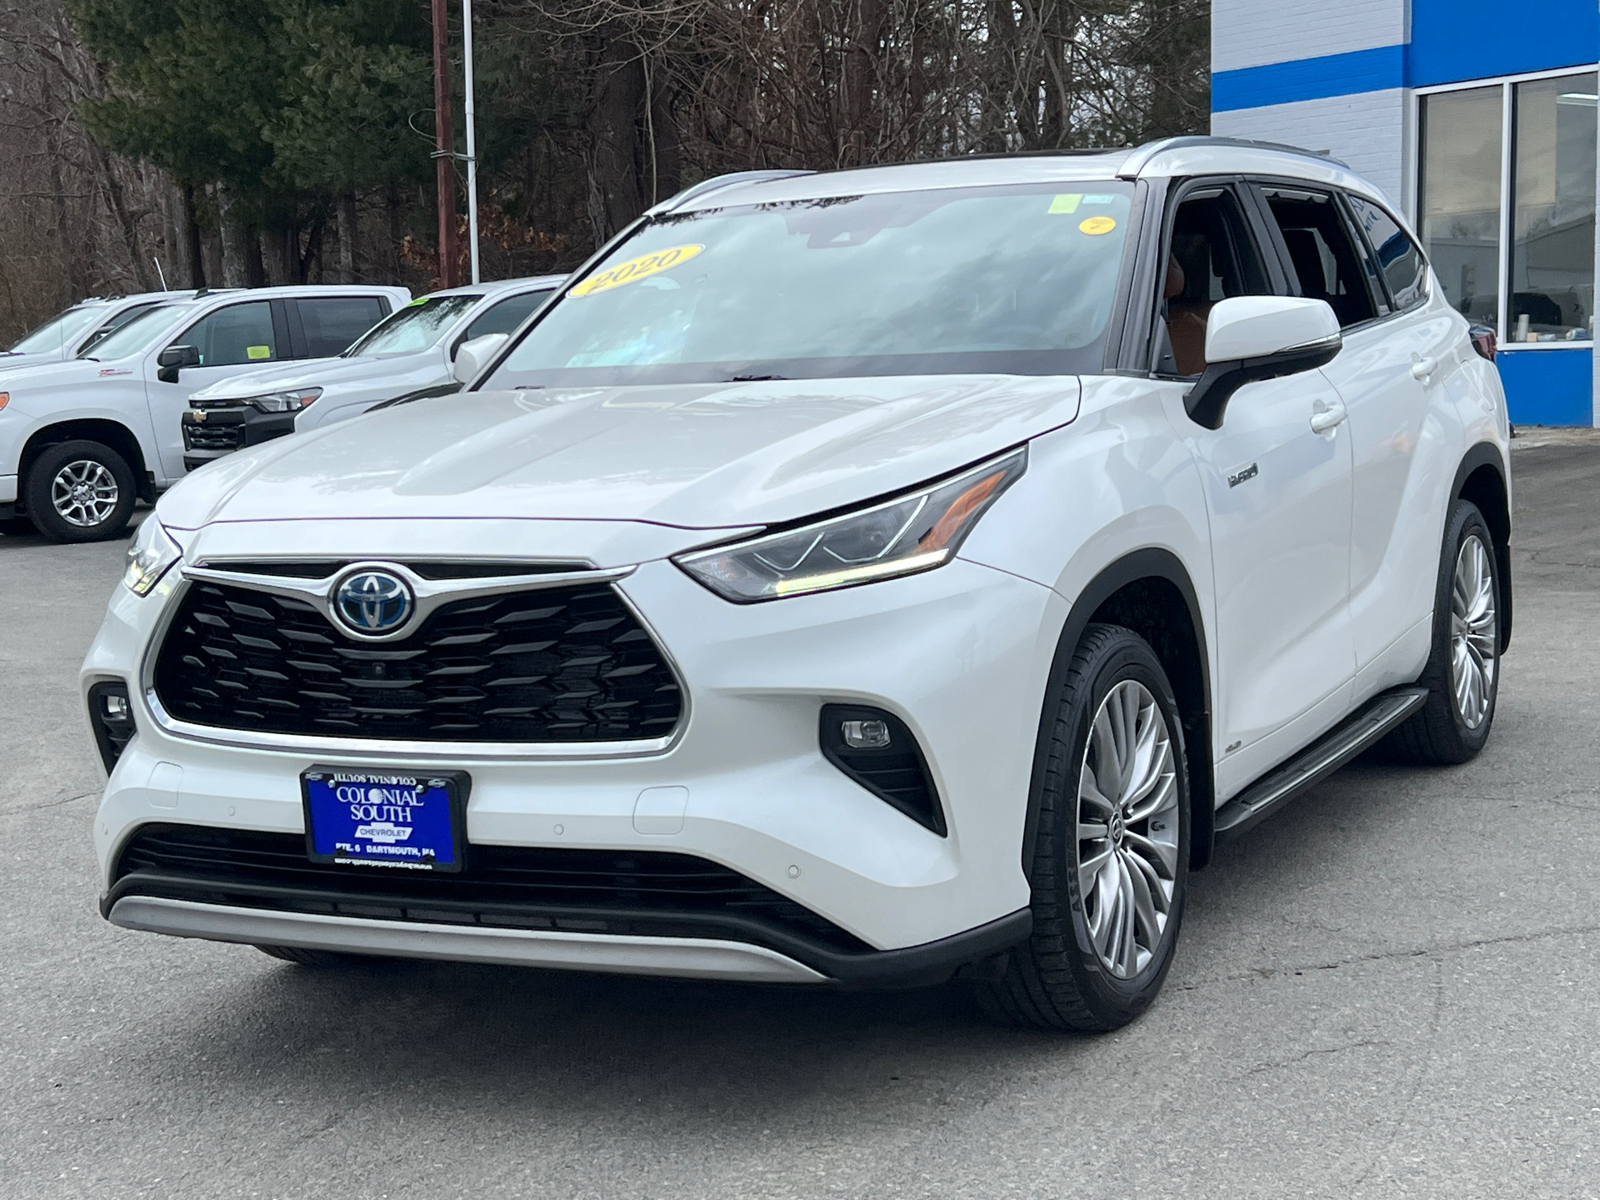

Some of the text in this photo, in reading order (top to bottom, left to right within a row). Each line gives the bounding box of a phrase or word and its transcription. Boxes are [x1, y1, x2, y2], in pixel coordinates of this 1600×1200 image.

[586, 249, 682, 293] 2020
[336, 786, 425, 807] COLONIAL
[350, 804, 412, 822] SOUTH
[359, 828, 407, 838] CHEVROLET
